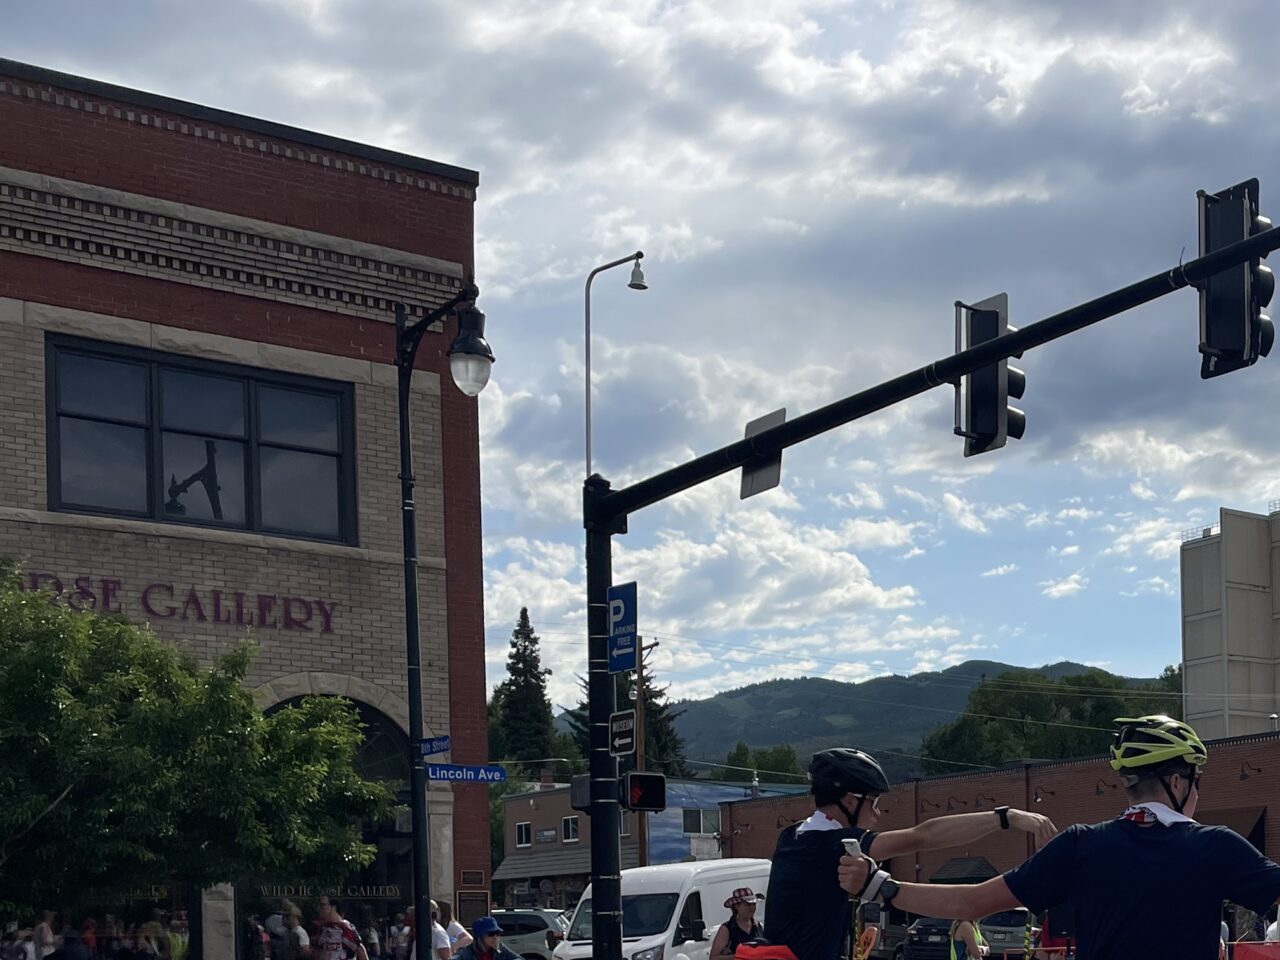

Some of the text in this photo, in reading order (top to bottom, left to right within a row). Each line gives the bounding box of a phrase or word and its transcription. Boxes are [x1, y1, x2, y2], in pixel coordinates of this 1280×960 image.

[142, 583, 338, 633] GALLERY
[617, 635, 631, 646] FREE
[612, 719, 634, 732] MUSEUM
[428, 767, 474, 779] Lincoln
[347, 885, 401, 897] GALLERY
